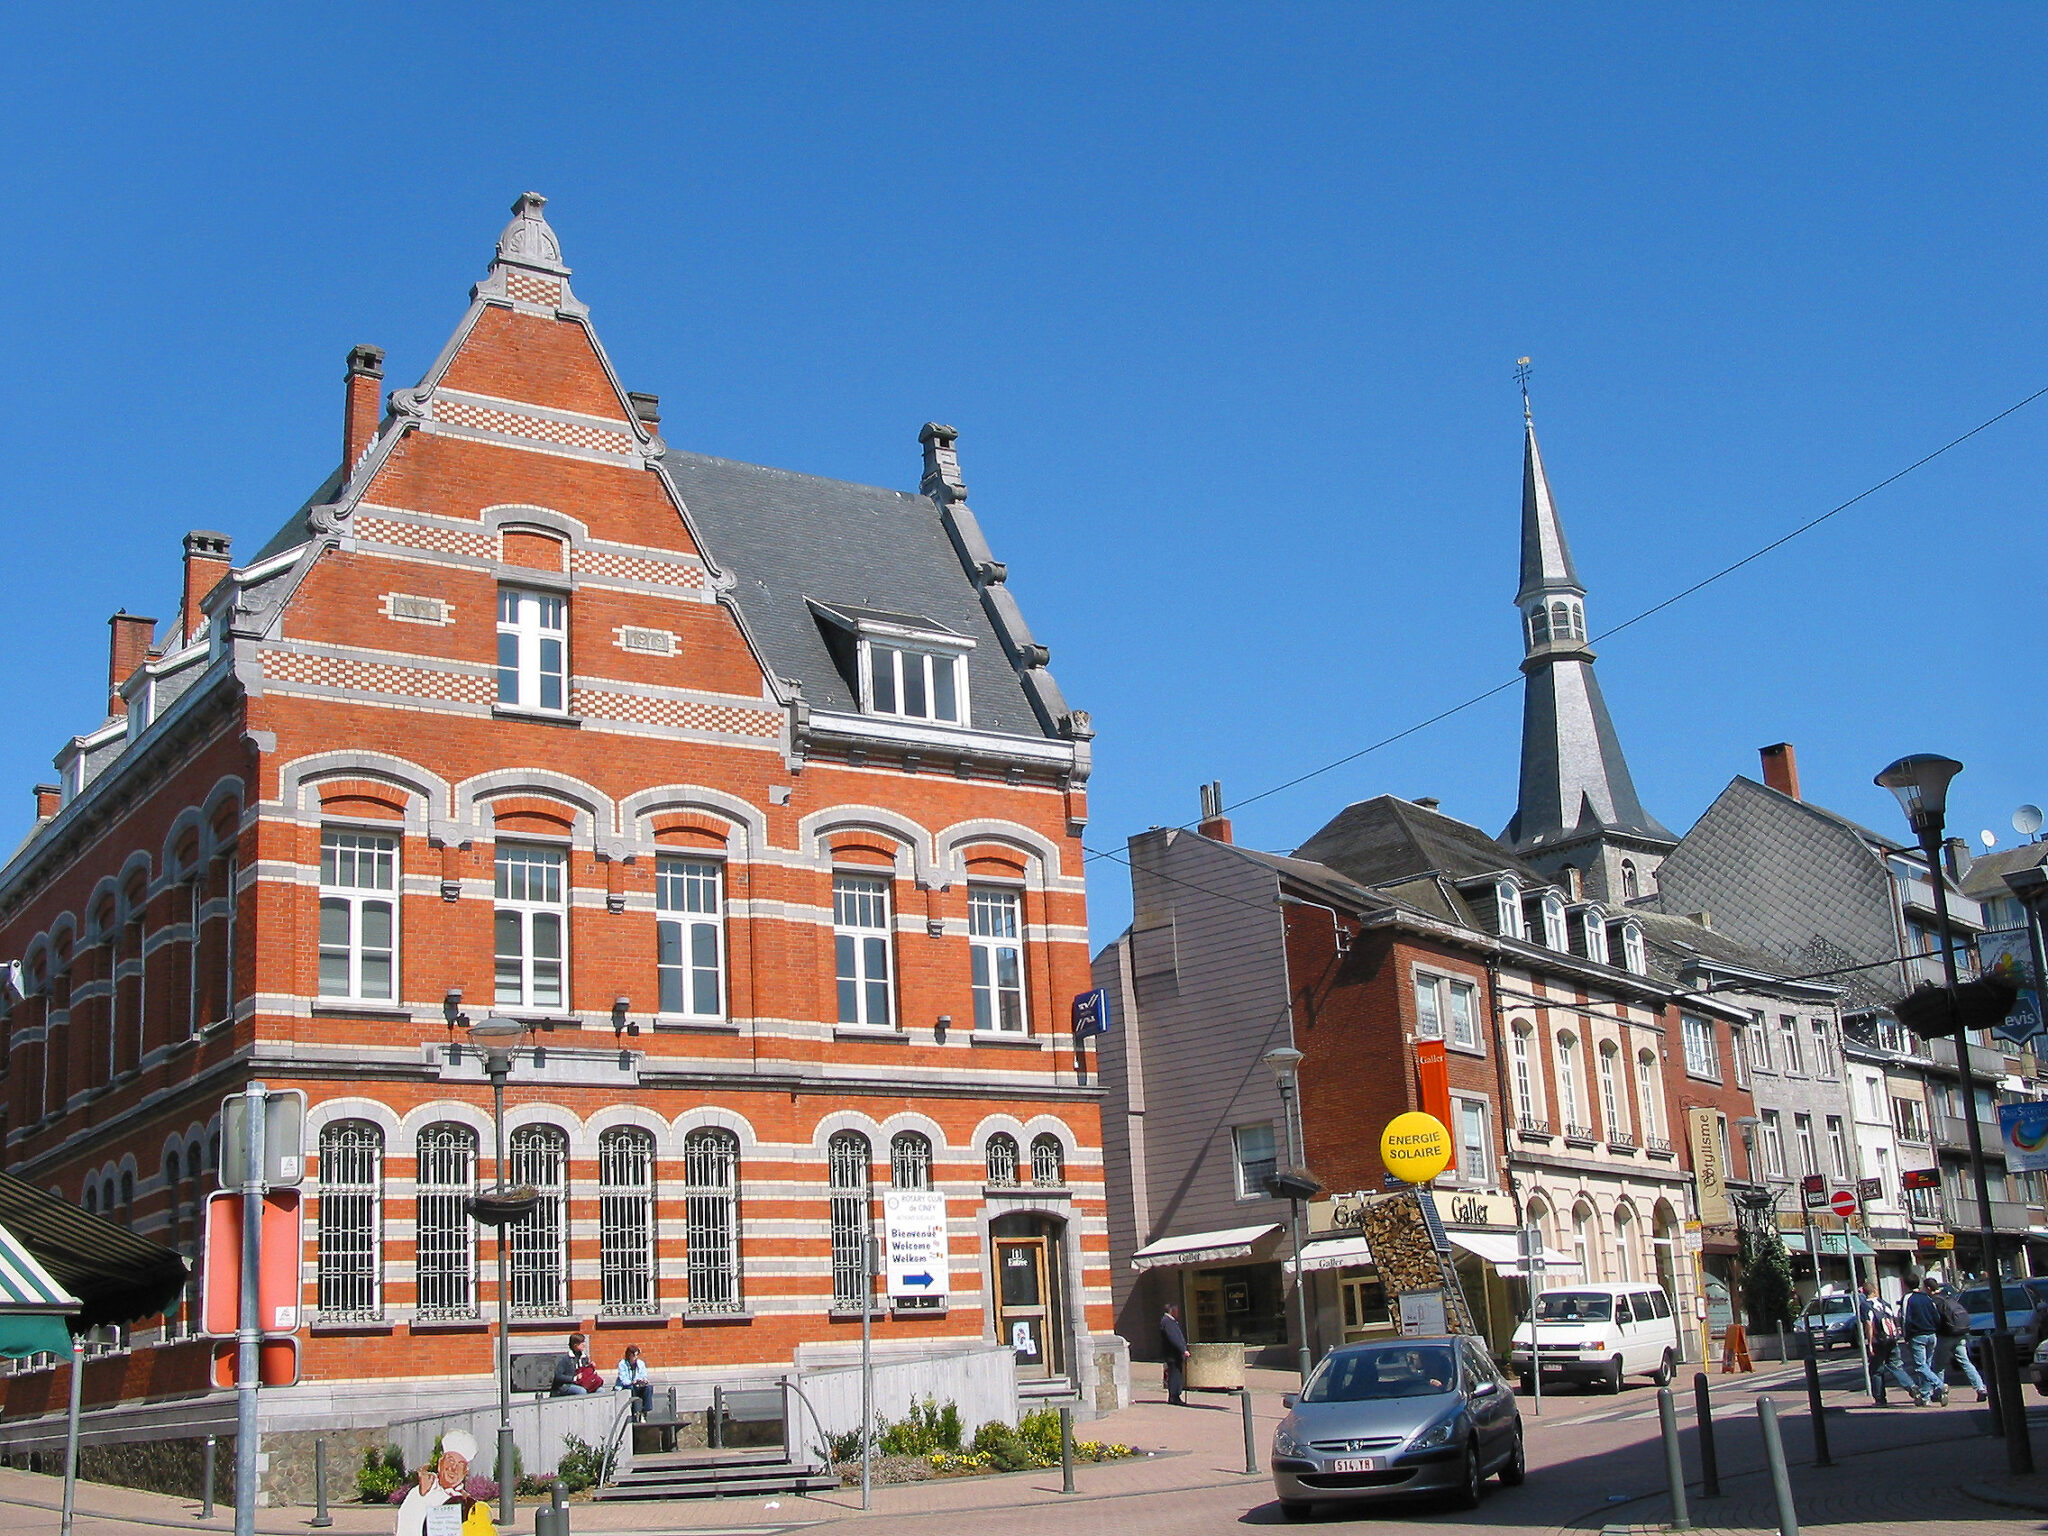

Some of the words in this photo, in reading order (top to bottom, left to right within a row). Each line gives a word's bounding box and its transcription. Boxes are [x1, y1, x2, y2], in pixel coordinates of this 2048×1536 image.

[2005, 1010, 2036, 1027] evis
[1420, 1055, 1444, 1065] Galler
[1388, 1131, 1441, 1146] ENERGIE
[1389, 1145, 1442, 1160] SOLAIRE
[1451, 1196, 1489, 1225] Galler
[891, 1228, 937, 1238] Bienvenue
[892, 1241, 931, 1250] Welcome
[892, 1253, 927, 1263] Welkom
[1319, 1258, 1343, 1268] Galler
